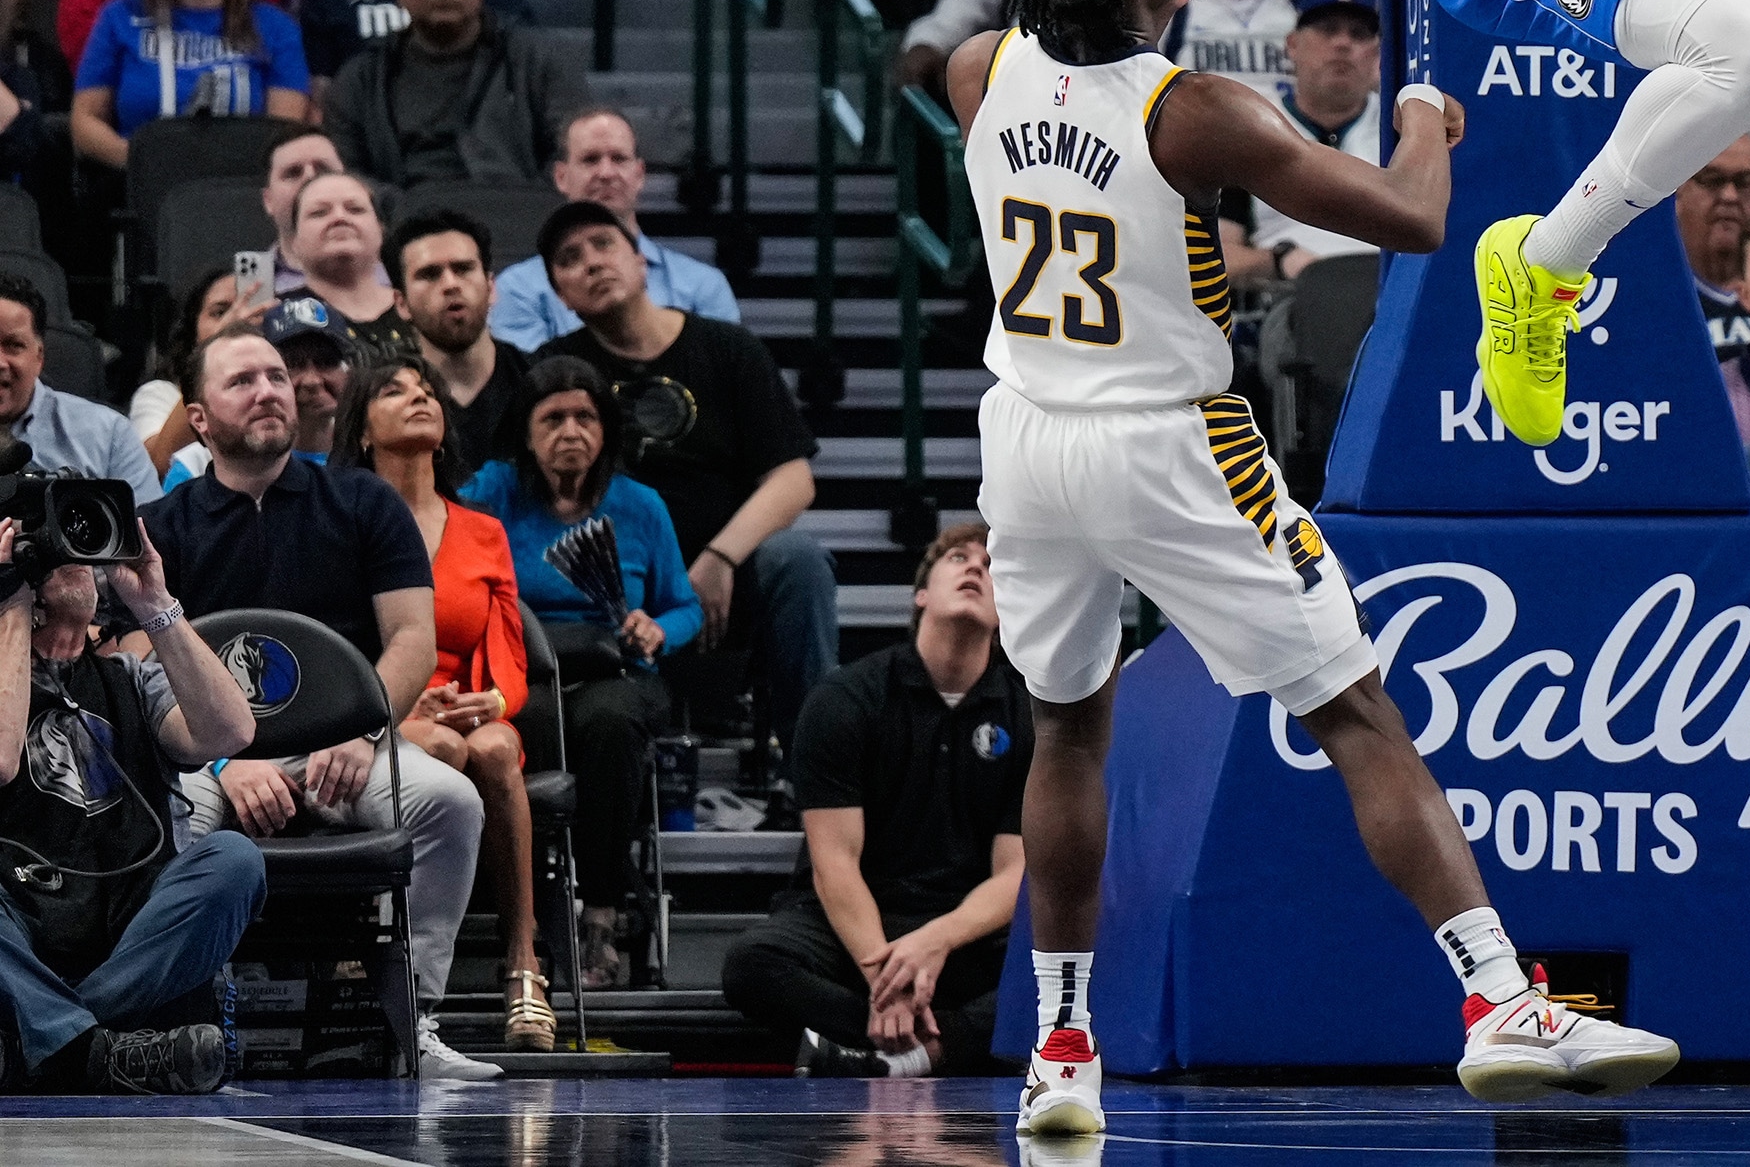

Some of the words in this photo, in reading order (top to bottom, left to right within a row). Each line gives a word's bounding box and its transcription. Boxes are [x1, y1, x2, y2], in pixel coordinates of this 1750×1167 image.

[999, 121, 1121, 192] NESMITH
[999, 195, 1123, 348] 23
[1488, 251, 1517, 355] AIR
[1440, 367, 1670, 485] Kger
[1447, 789, 1698, 875] PORTS
